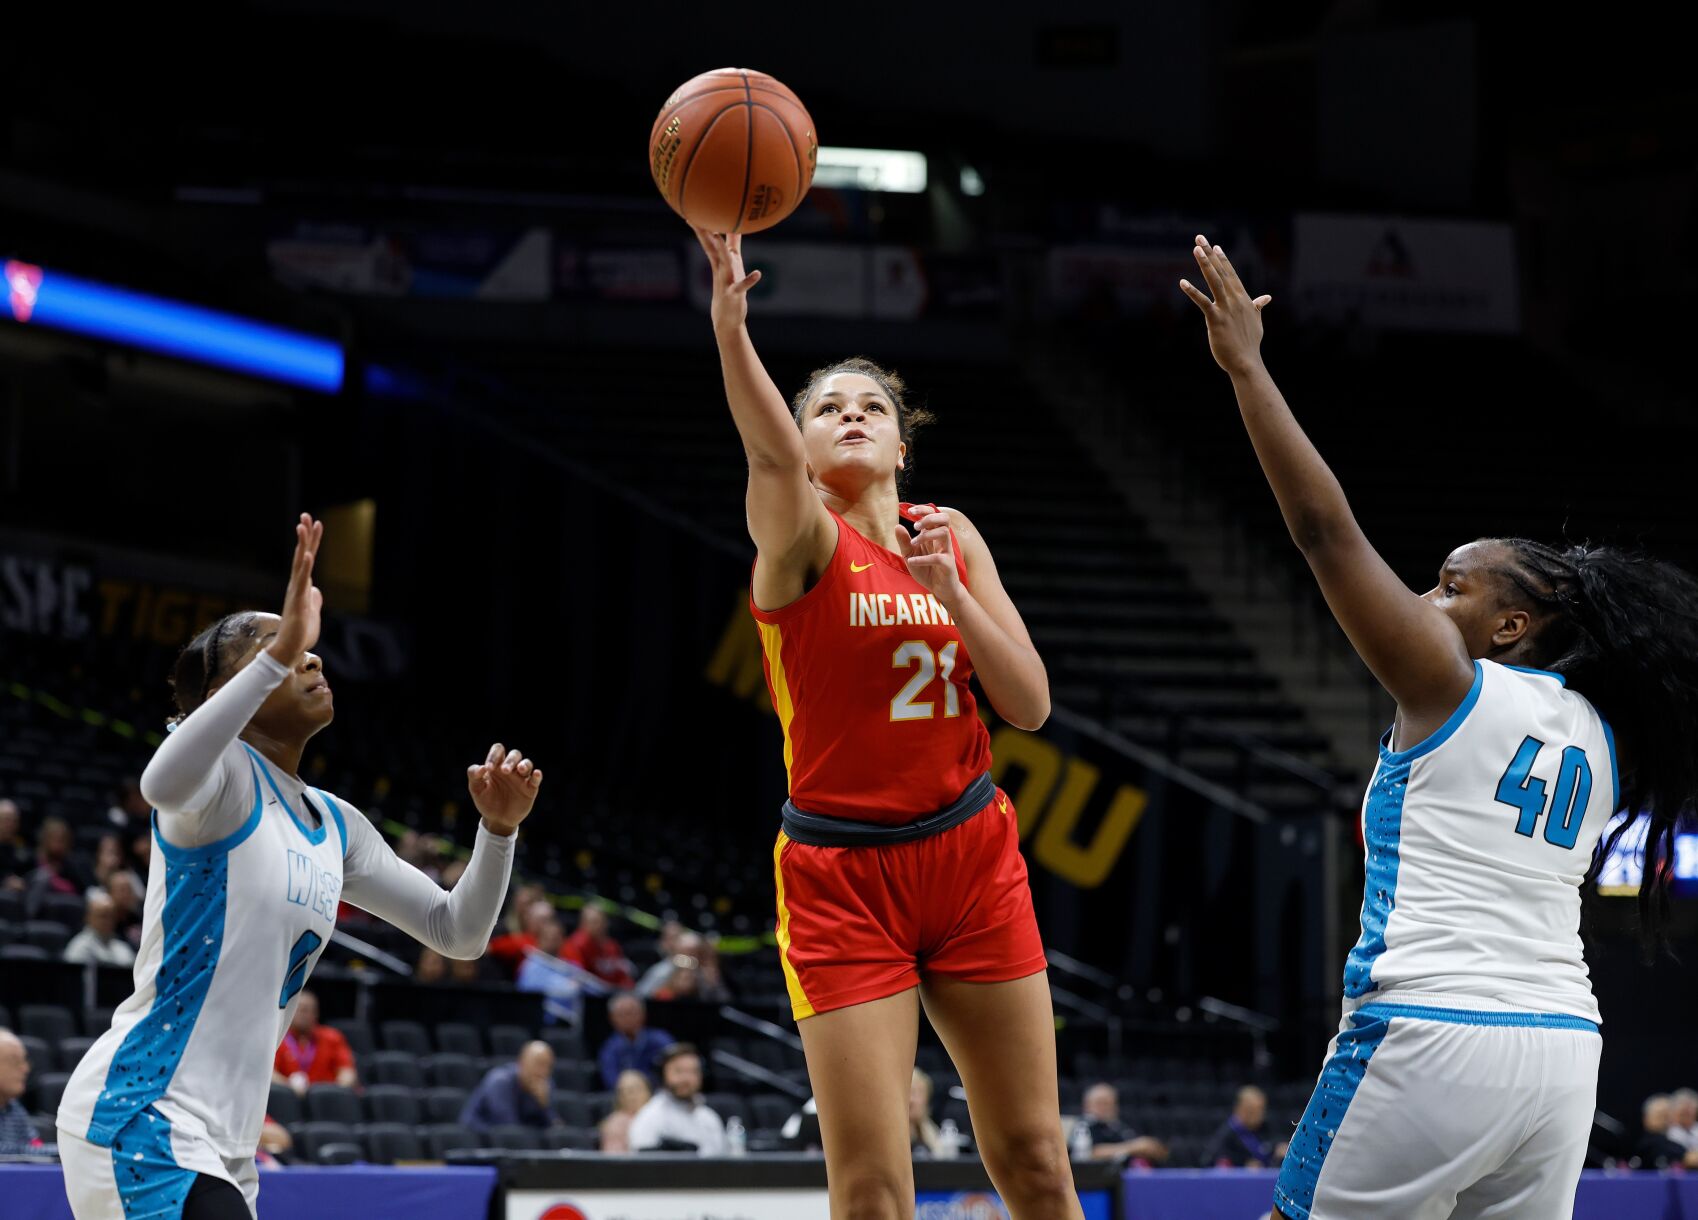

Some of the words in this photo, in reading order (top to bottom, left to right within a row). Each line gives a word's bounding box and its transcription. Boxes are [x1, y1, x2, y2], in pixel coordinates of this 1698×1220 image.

[849, 592, 956, 626] INCARN
[889, 639, 960, 722] 21
[1494, 734, 1593, 851] 40
[287, 848, 341, 923] WES
